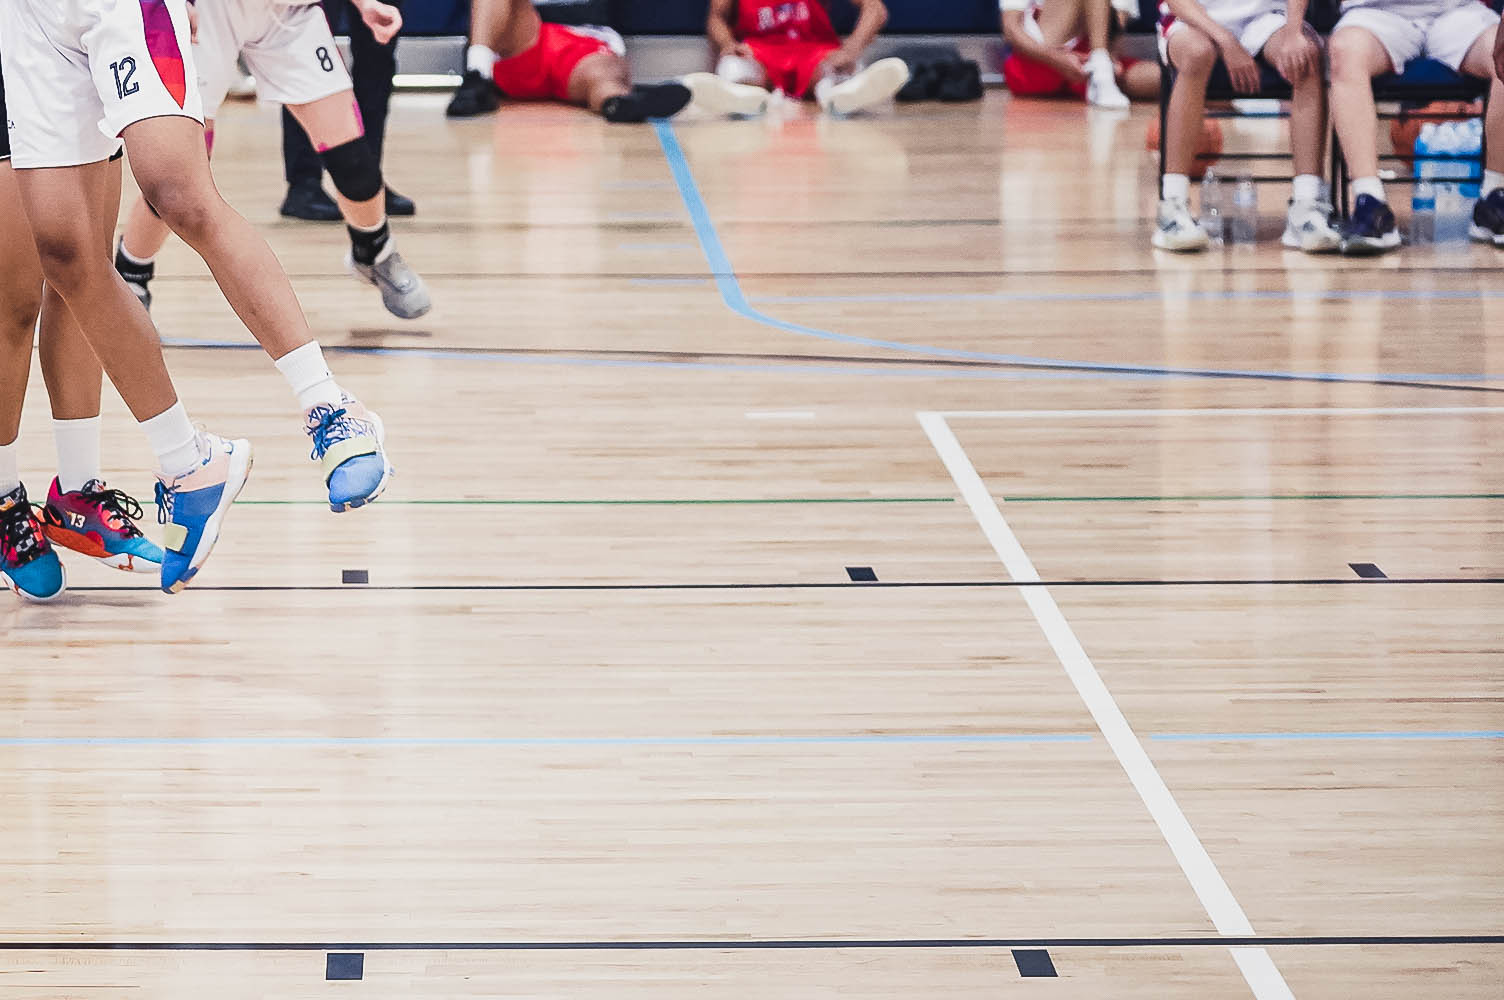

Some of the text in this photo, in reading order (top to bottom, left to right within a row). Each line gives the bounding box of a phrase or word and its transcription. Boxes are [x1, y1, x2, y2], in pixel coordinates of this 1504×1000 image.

[315, 46, 334, 73] 8
[109, 55, 140, 100] 12
[70, 512, 86, 529] 13
